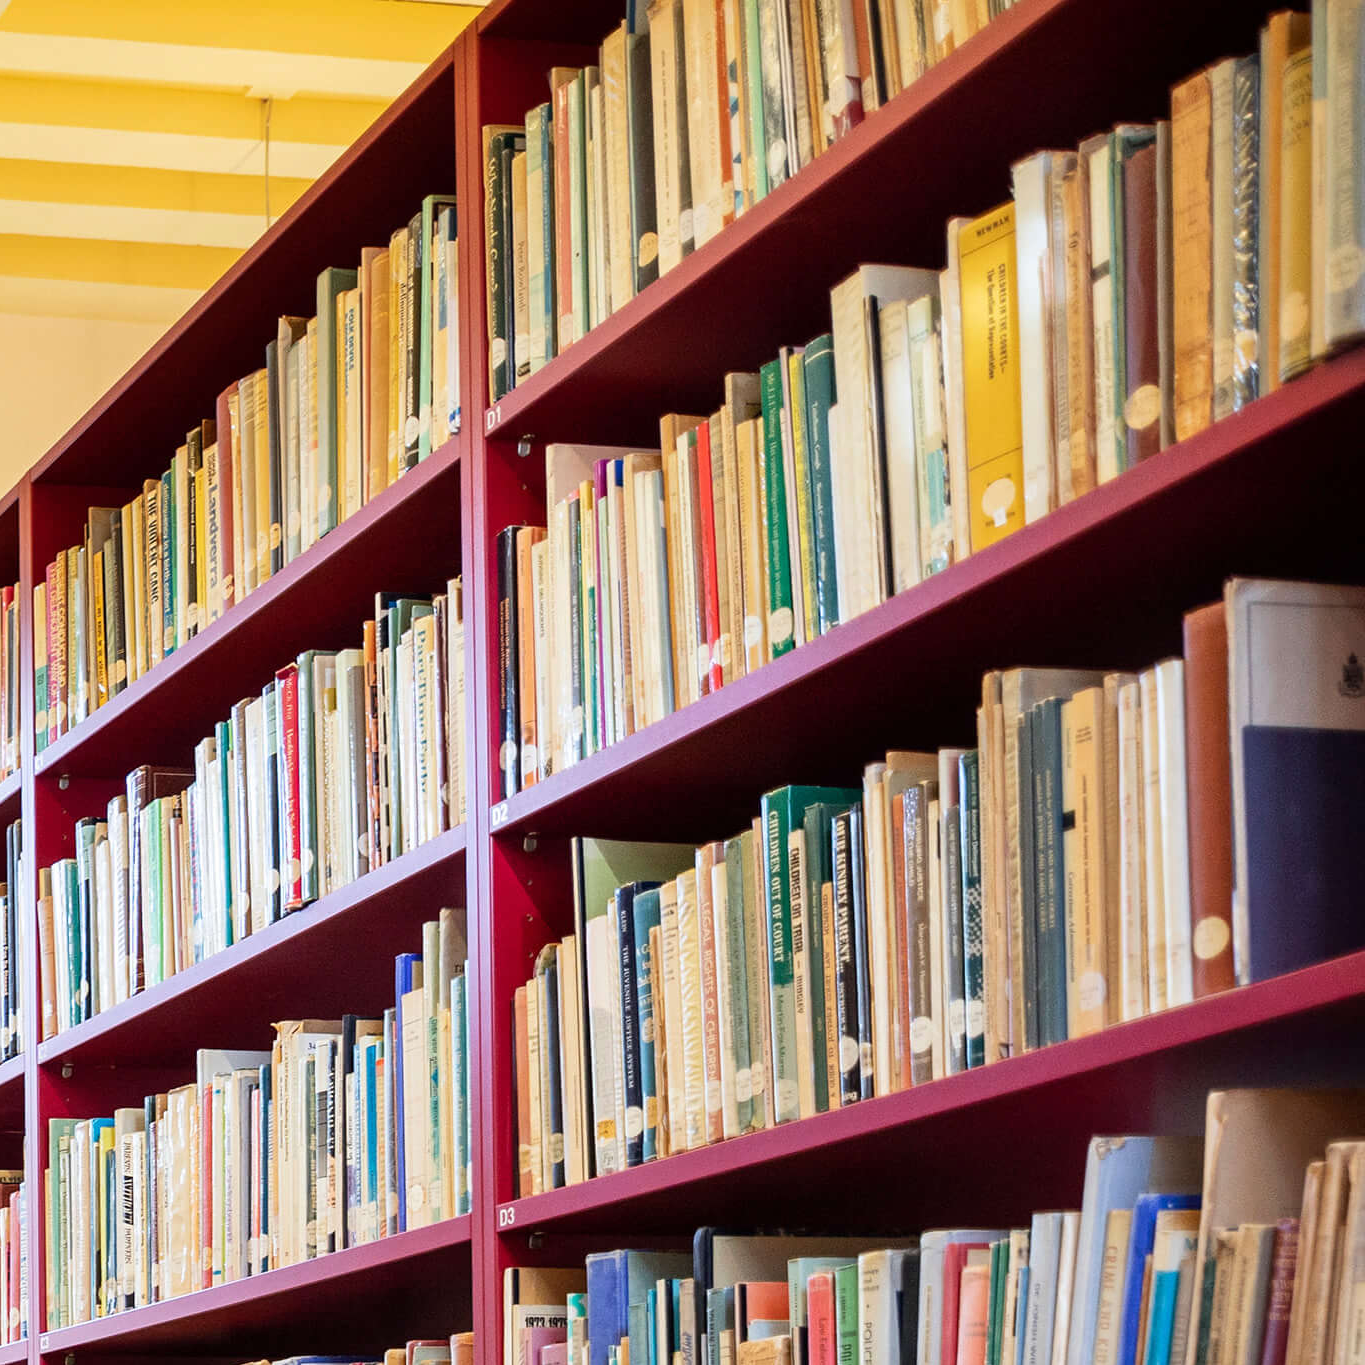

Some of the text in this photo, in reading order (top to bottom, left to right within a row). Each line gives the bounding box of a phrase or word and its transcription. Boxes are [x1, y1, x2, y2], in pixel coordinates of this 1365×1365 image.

[976, 216, 1010, 237] NEWMAN
[487, 405, 501, 429] D1
[492, 803, 508, 826] D2
[769, 810, 784, 963] CHILDREN OUT OF COURT
[790, 847, 803, 902] CHILDREN
[837, 853, 848, 904] KINDLY
[792, 904, 803, 918] ON
[793, 923, 804, 955] TRIAL
[700, 902, 717, 1081] LEGAL RIGHTS OF CHILDREN
[499, 1206, 515, 1227] D3
[1103, 1246, 1119, 1289] CRIME
[818, 1317, 827, 1334] Law
[1100, 1300, 1115, 1331] AND
[864, 1321, 873, 1365] POLICE
